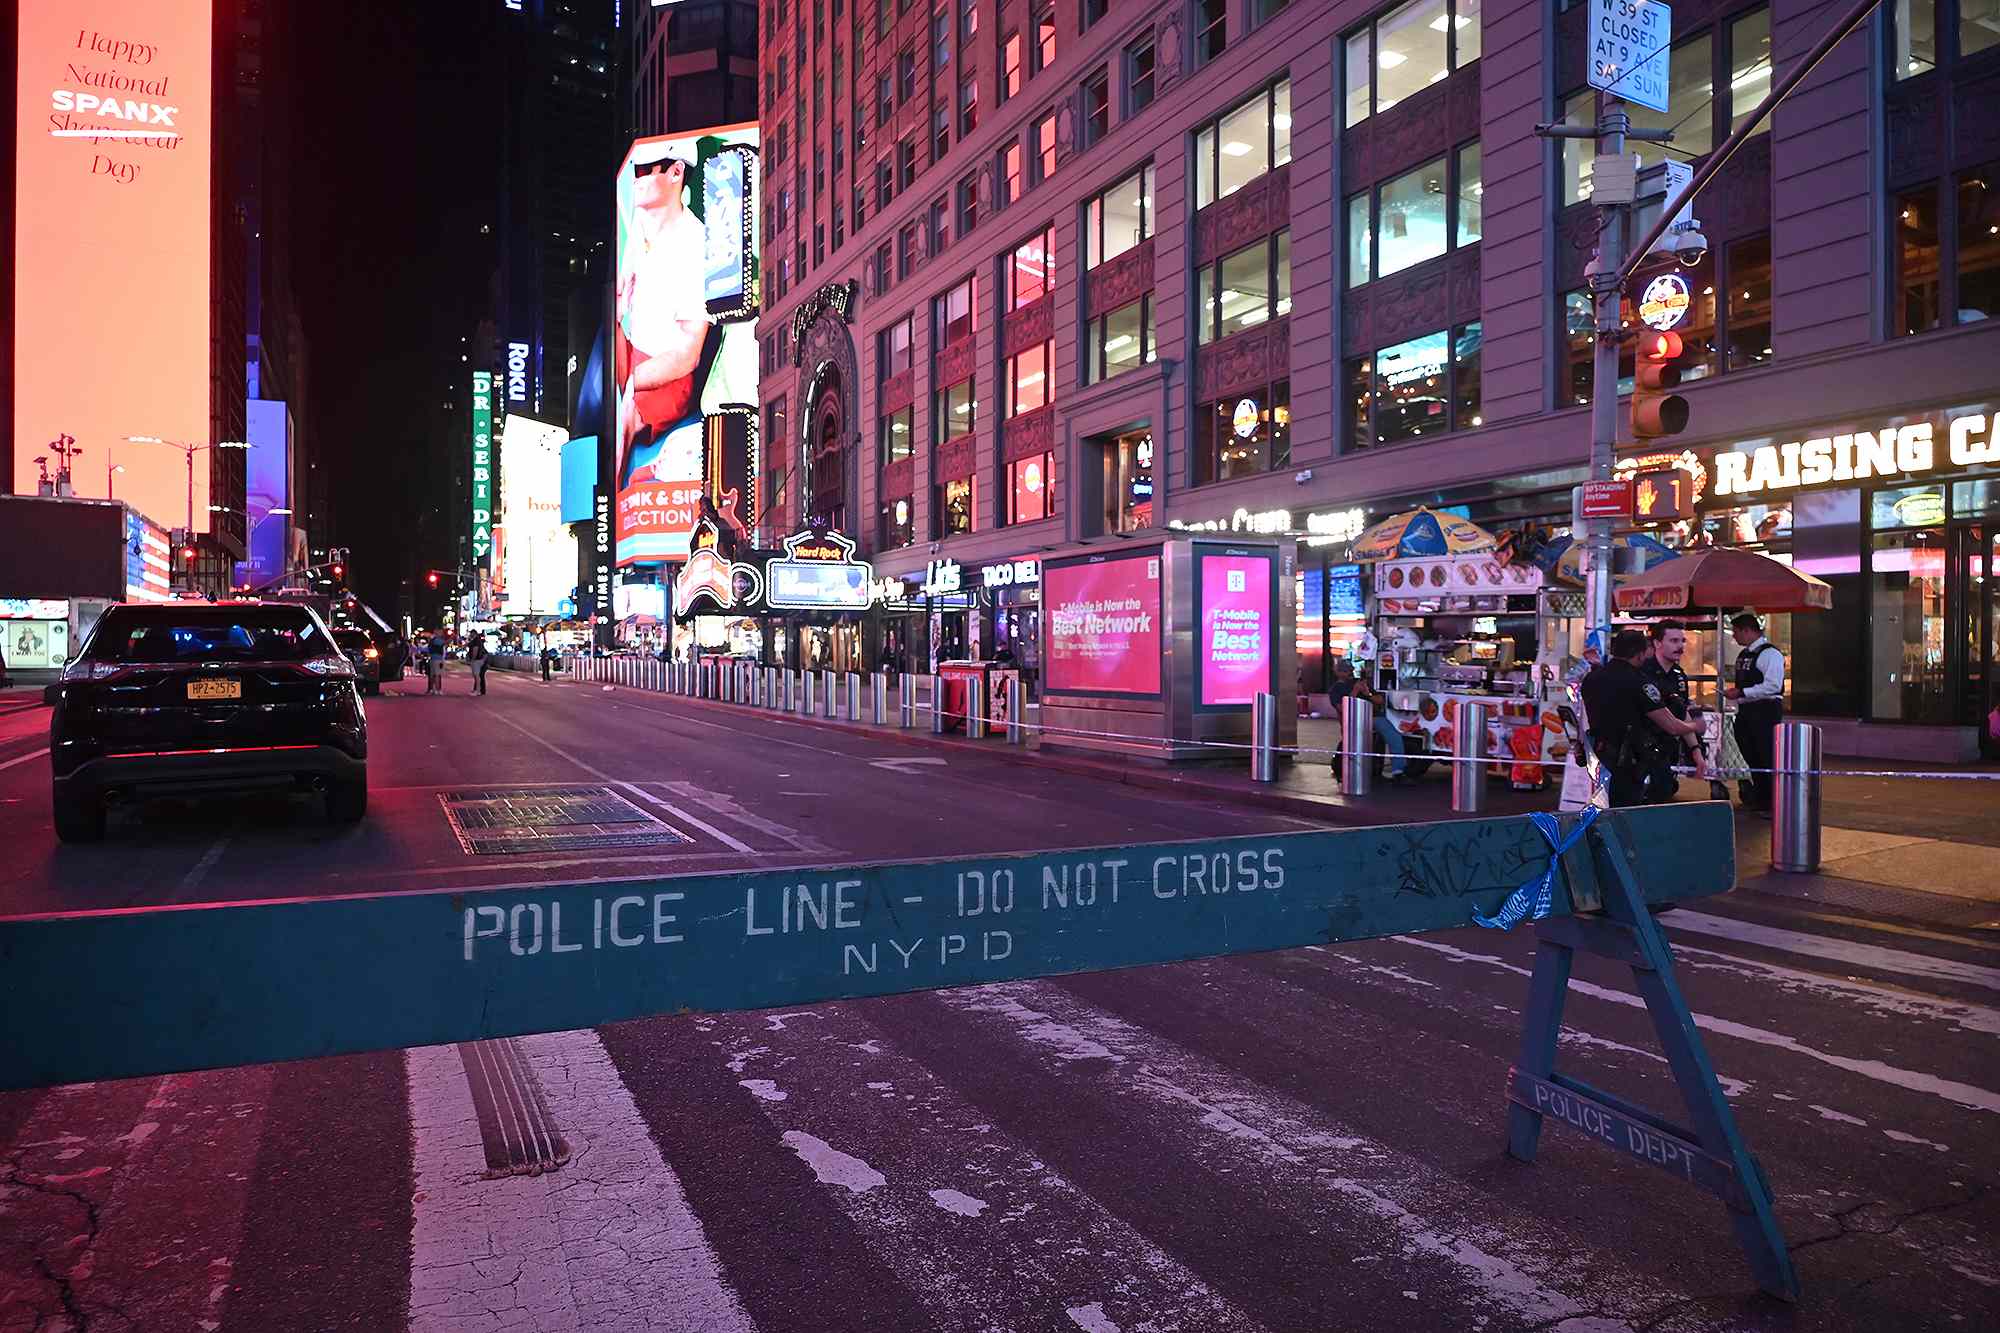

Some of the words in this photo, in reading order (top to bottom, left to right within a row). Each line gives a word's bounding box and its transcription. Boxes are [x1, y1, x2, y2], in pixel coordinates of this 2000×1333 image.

[1619, 0, 1637, 19] 39
[1642, 9, 1658, 28] ST
[77, 30, 158, 65] Happy
[1601, 16, 1658, 50] CLOSED
[1596, 38, 1615, 57] AT
[1620, 46, 1629, 62] 9
[1634, 53, 1662, 76] AVE
[64, 63, 168, 97] National
[52, 89, 178, 127] SPANX
[91, 155, 141, 184] Day
[1714, 421, 1933, 496] RAISING
[656, 490, 669, 506] &
[473, 509, 491, 556] DAY
[597, 495, 609, 553] SQUARE
[795, 545, 819, 558] Hard
[820, 547, 841, 560] Rock
[597, 565, 609, 609] TIMES
[982, 563, 1013, 588] TACO
[1104, 600, 1124, 612] Now
[1125, 598, 1141, 610] the
[1213, 608, 1260, 620] T-Mobile
[1052, 614, 1083, 636] Best
[1085, 611, 1152, 635] Network
[1212, 630, 1261, 650] Best
[1211, 651, 1260, 662] Network
[463, 892, 686, 961] POLICE
[745, 879, 863, 937] LINE
[958, 868, 1014, 918] DO
[1042, 860, 1129, 910] NOT
[1152, 848, 1285, 900] CROSS
[1534, 1083, 1616, 1142] POLICE
[1627, 1125, 1695, 1184] DEPT
